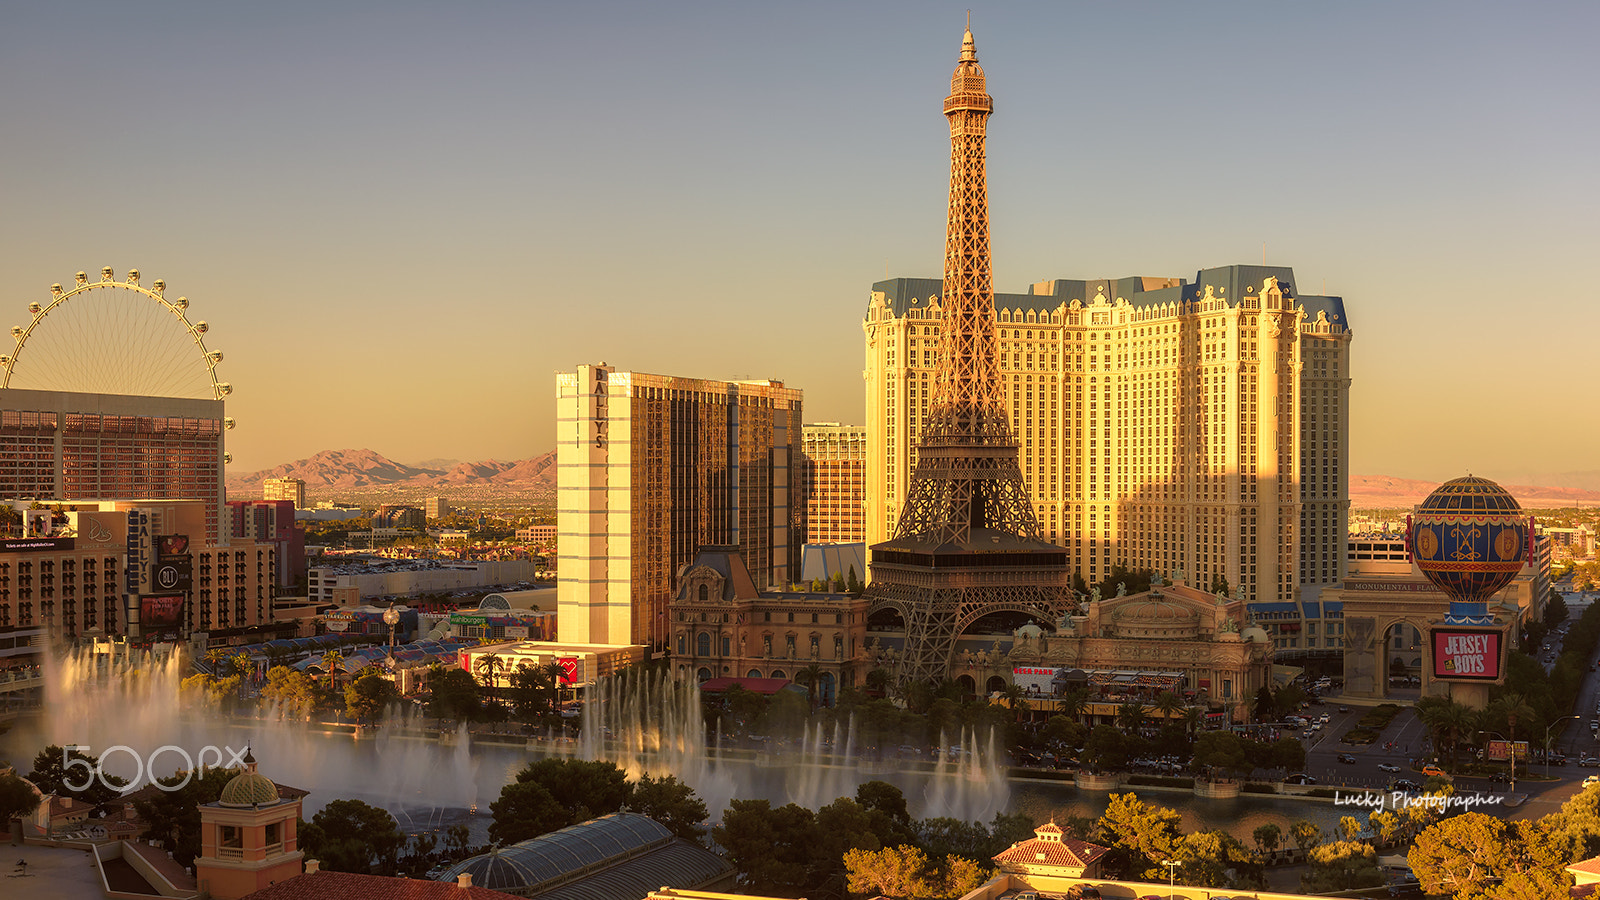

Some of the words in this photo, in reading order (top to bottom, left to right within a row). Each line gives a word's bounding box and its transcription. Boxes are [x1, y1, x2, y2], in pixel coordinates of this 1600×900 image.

[1354, 583, 1412, 591] MONUMENTAL
[417, 602, 458, 615] BALLY'S
[1445, 634, 1489, 656] JERSEY
[1453, 654, 1485, 674] BOYS
[1013, 667, 1032, 675] BEER
